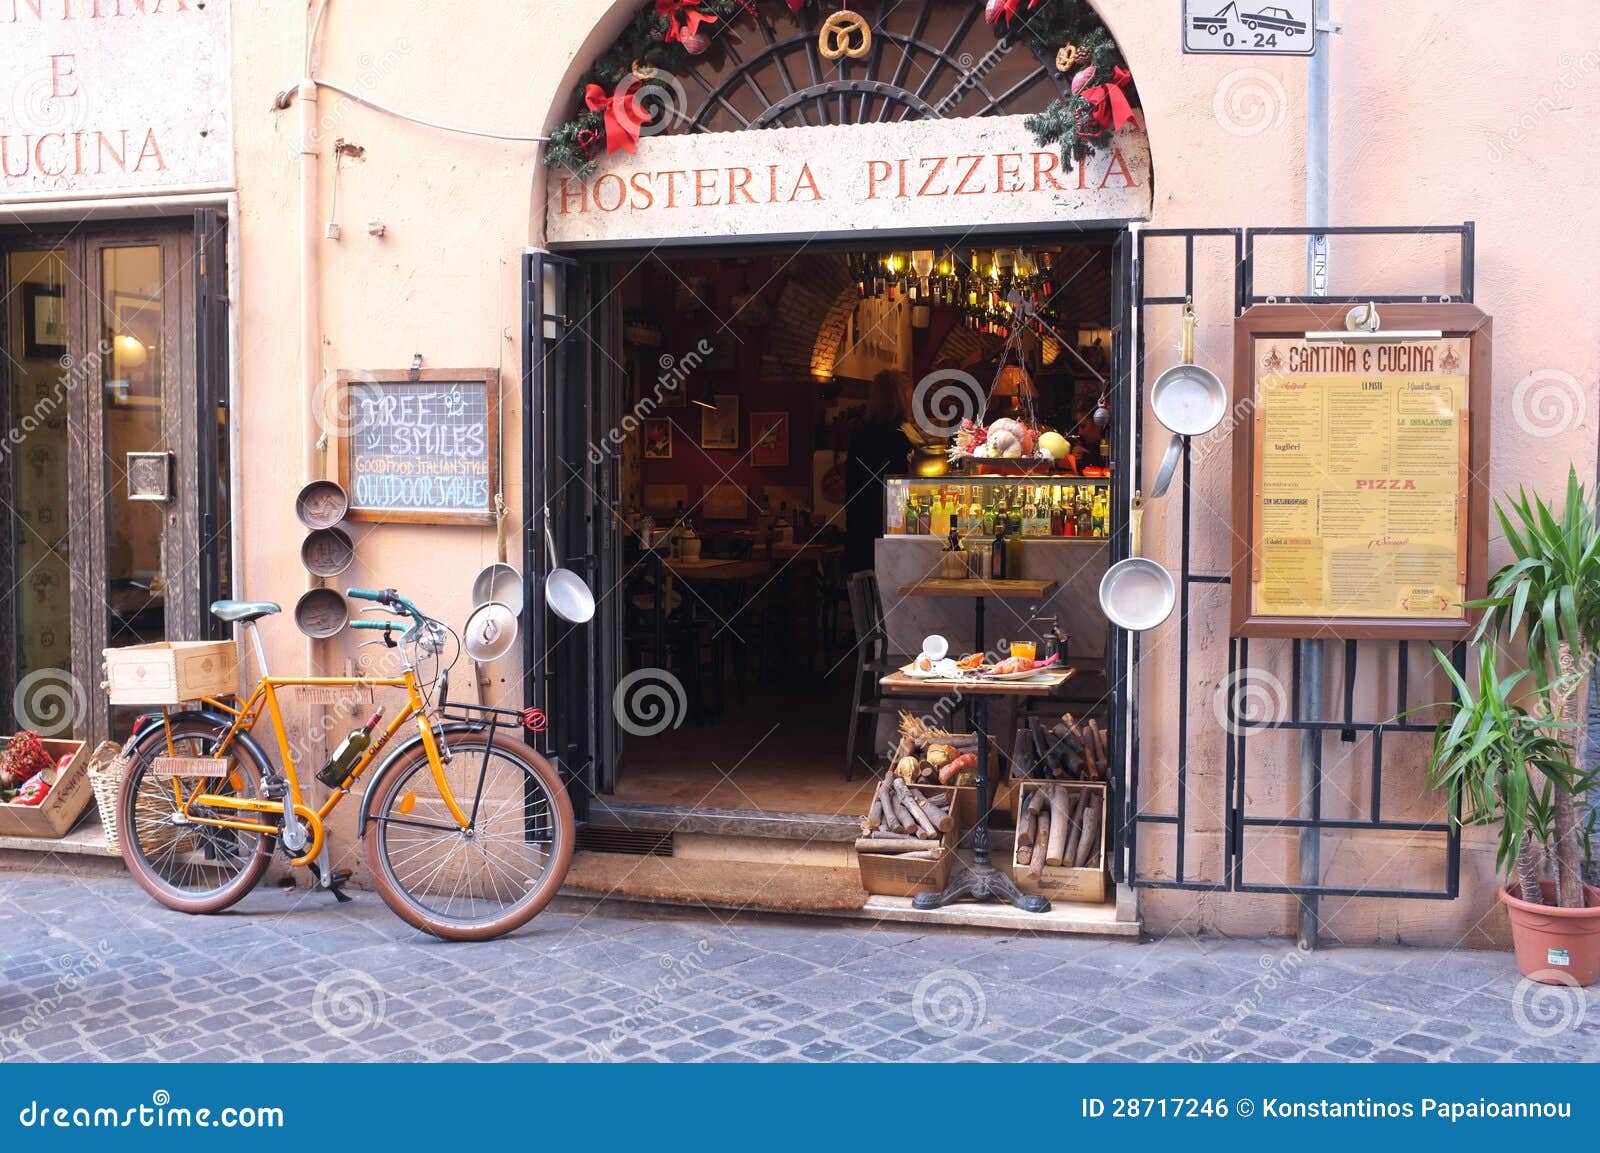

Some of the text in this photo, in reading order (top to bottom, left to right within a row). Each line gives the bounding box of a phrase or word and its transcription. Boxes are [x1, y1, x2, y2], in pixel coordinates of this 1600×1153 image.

[1223, 33, 1235, 47] 0
[1254, 33, 1277, 47] 24
[48, 54, 78, 98] E
[1, 127, 170, 178] UCINA
[560, 147, 1139, 215] HOSTERIA PIZZERIA
[1289, 346, 1356, 373] CANTINA
[1378, 346, 1434, 373] CUCINA
[361, 392, 437, 427] FREE
[391, 423, 485, 456] SMILES
[355, 456, 386, 474] GOOD
[357, 475, 488, 507] OUTDOOR TABLES
[1356, 480, 1416, 490] PIZZA
